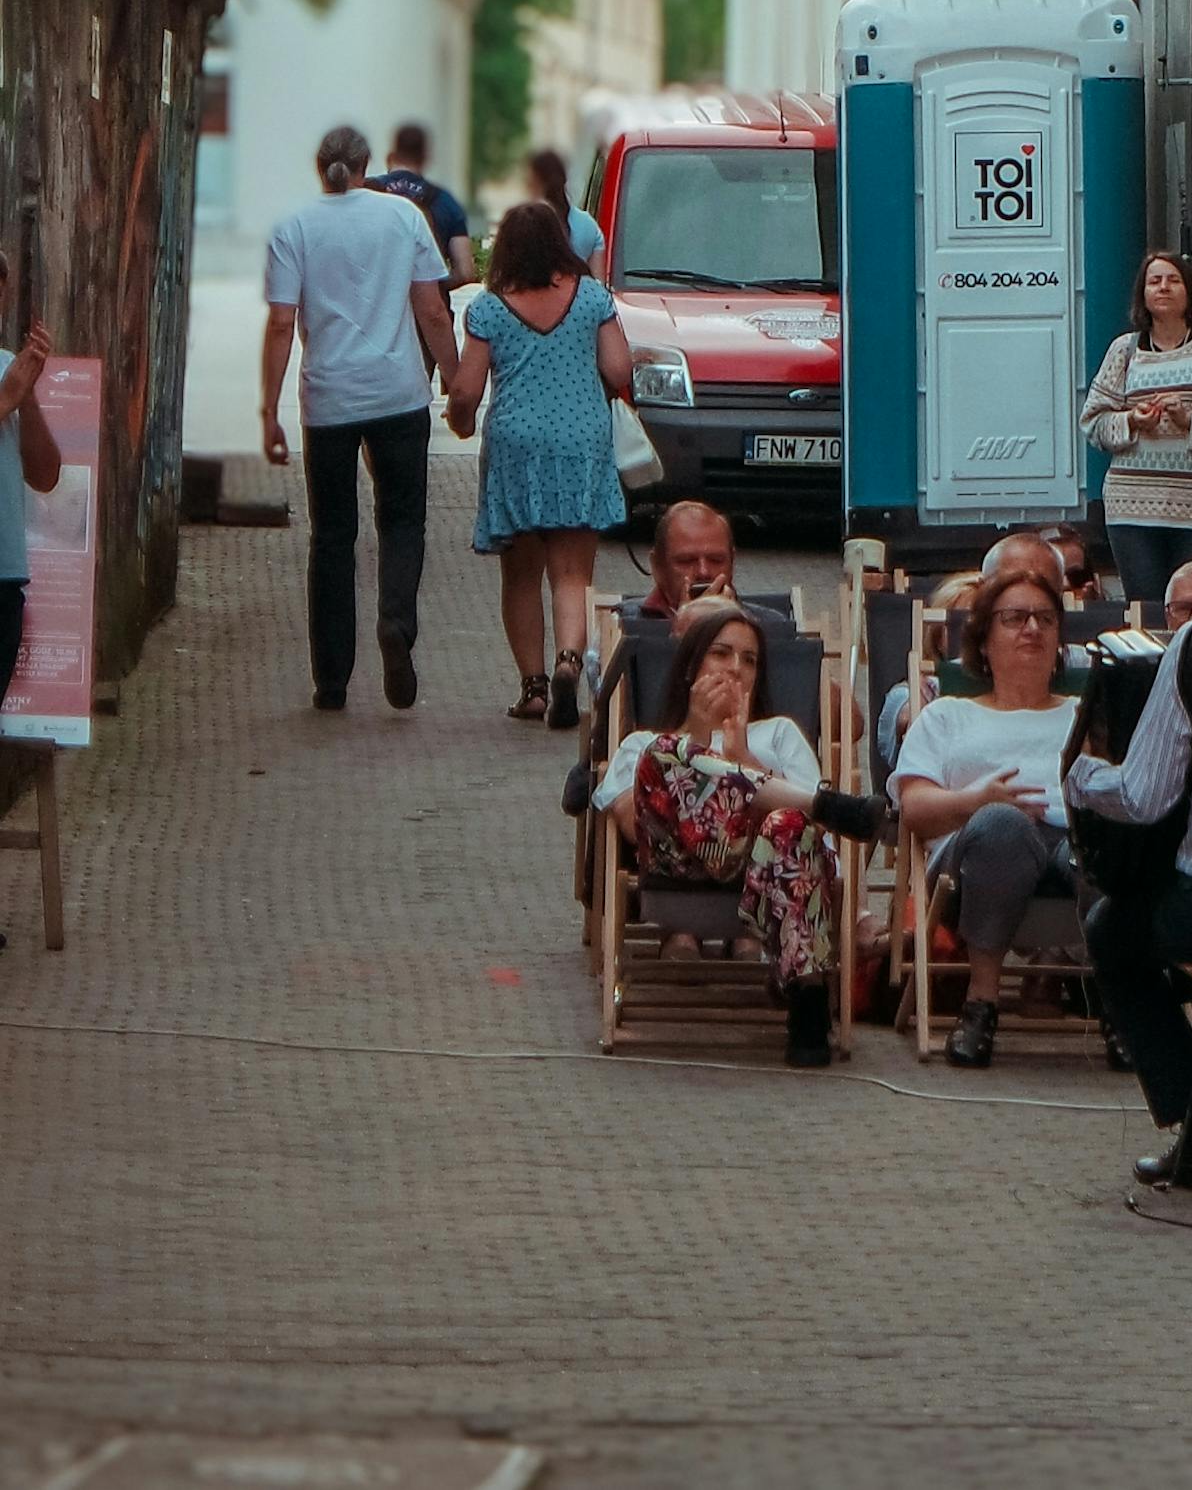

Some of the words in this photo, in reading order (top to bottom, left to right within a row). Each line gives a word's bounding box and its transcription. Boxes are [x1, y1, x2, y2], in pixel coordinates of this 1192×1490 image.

[974, 158, 1033, 189] TOI
[974, 191, 1033, 221] TOI
[954, 273, 987, 288] 804
[991, 273, 1023, 287] 204
[1026, 272, 1059, 286] 204
[756, 438, 797, 460] FNW
[967, 436, 1037, 460] HMT
